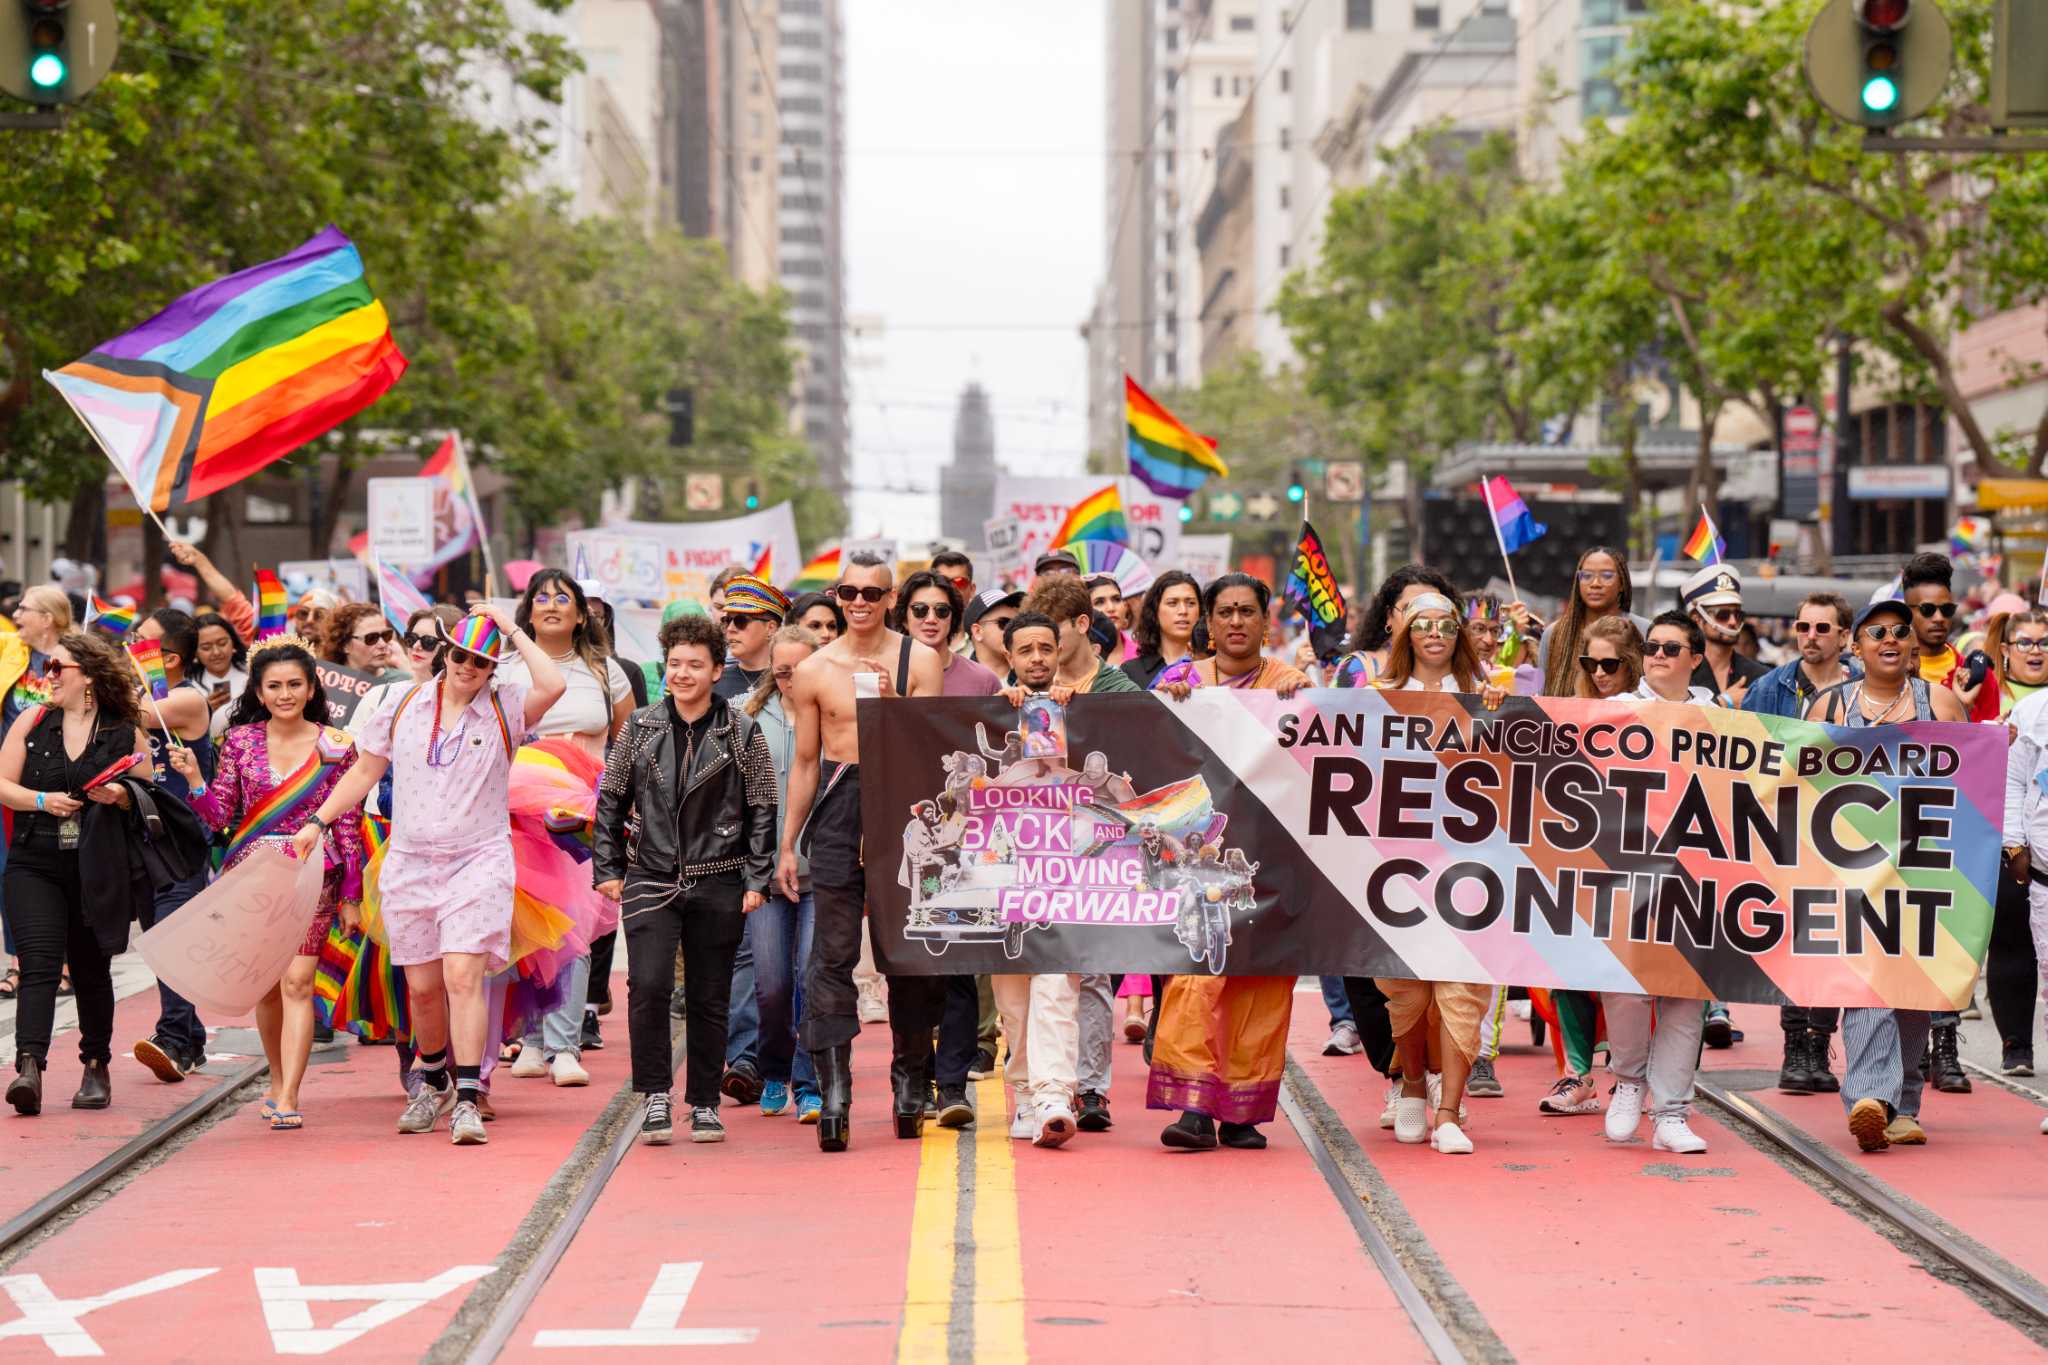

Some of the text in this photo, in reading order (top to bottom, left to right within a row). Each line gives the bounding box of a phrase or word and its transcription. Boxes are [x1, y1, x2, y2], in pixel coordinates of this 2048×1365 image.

[1128, 504, 1162, 522] OR
[1276, 712, 1962, 779] SAN FRANCISCO PRIDE BOARD
[969, 785, 1094, 810] LOOKING
[1307, 755, 1957, 871] RESISTANCE
[962, 813, 1125, 850] BACK AND
[1018, 857, 1143, 885] MOVING
[1001, 890, 1181, 922] FORWARD
[1366, 857, 1954, 958] CONTINGENT
